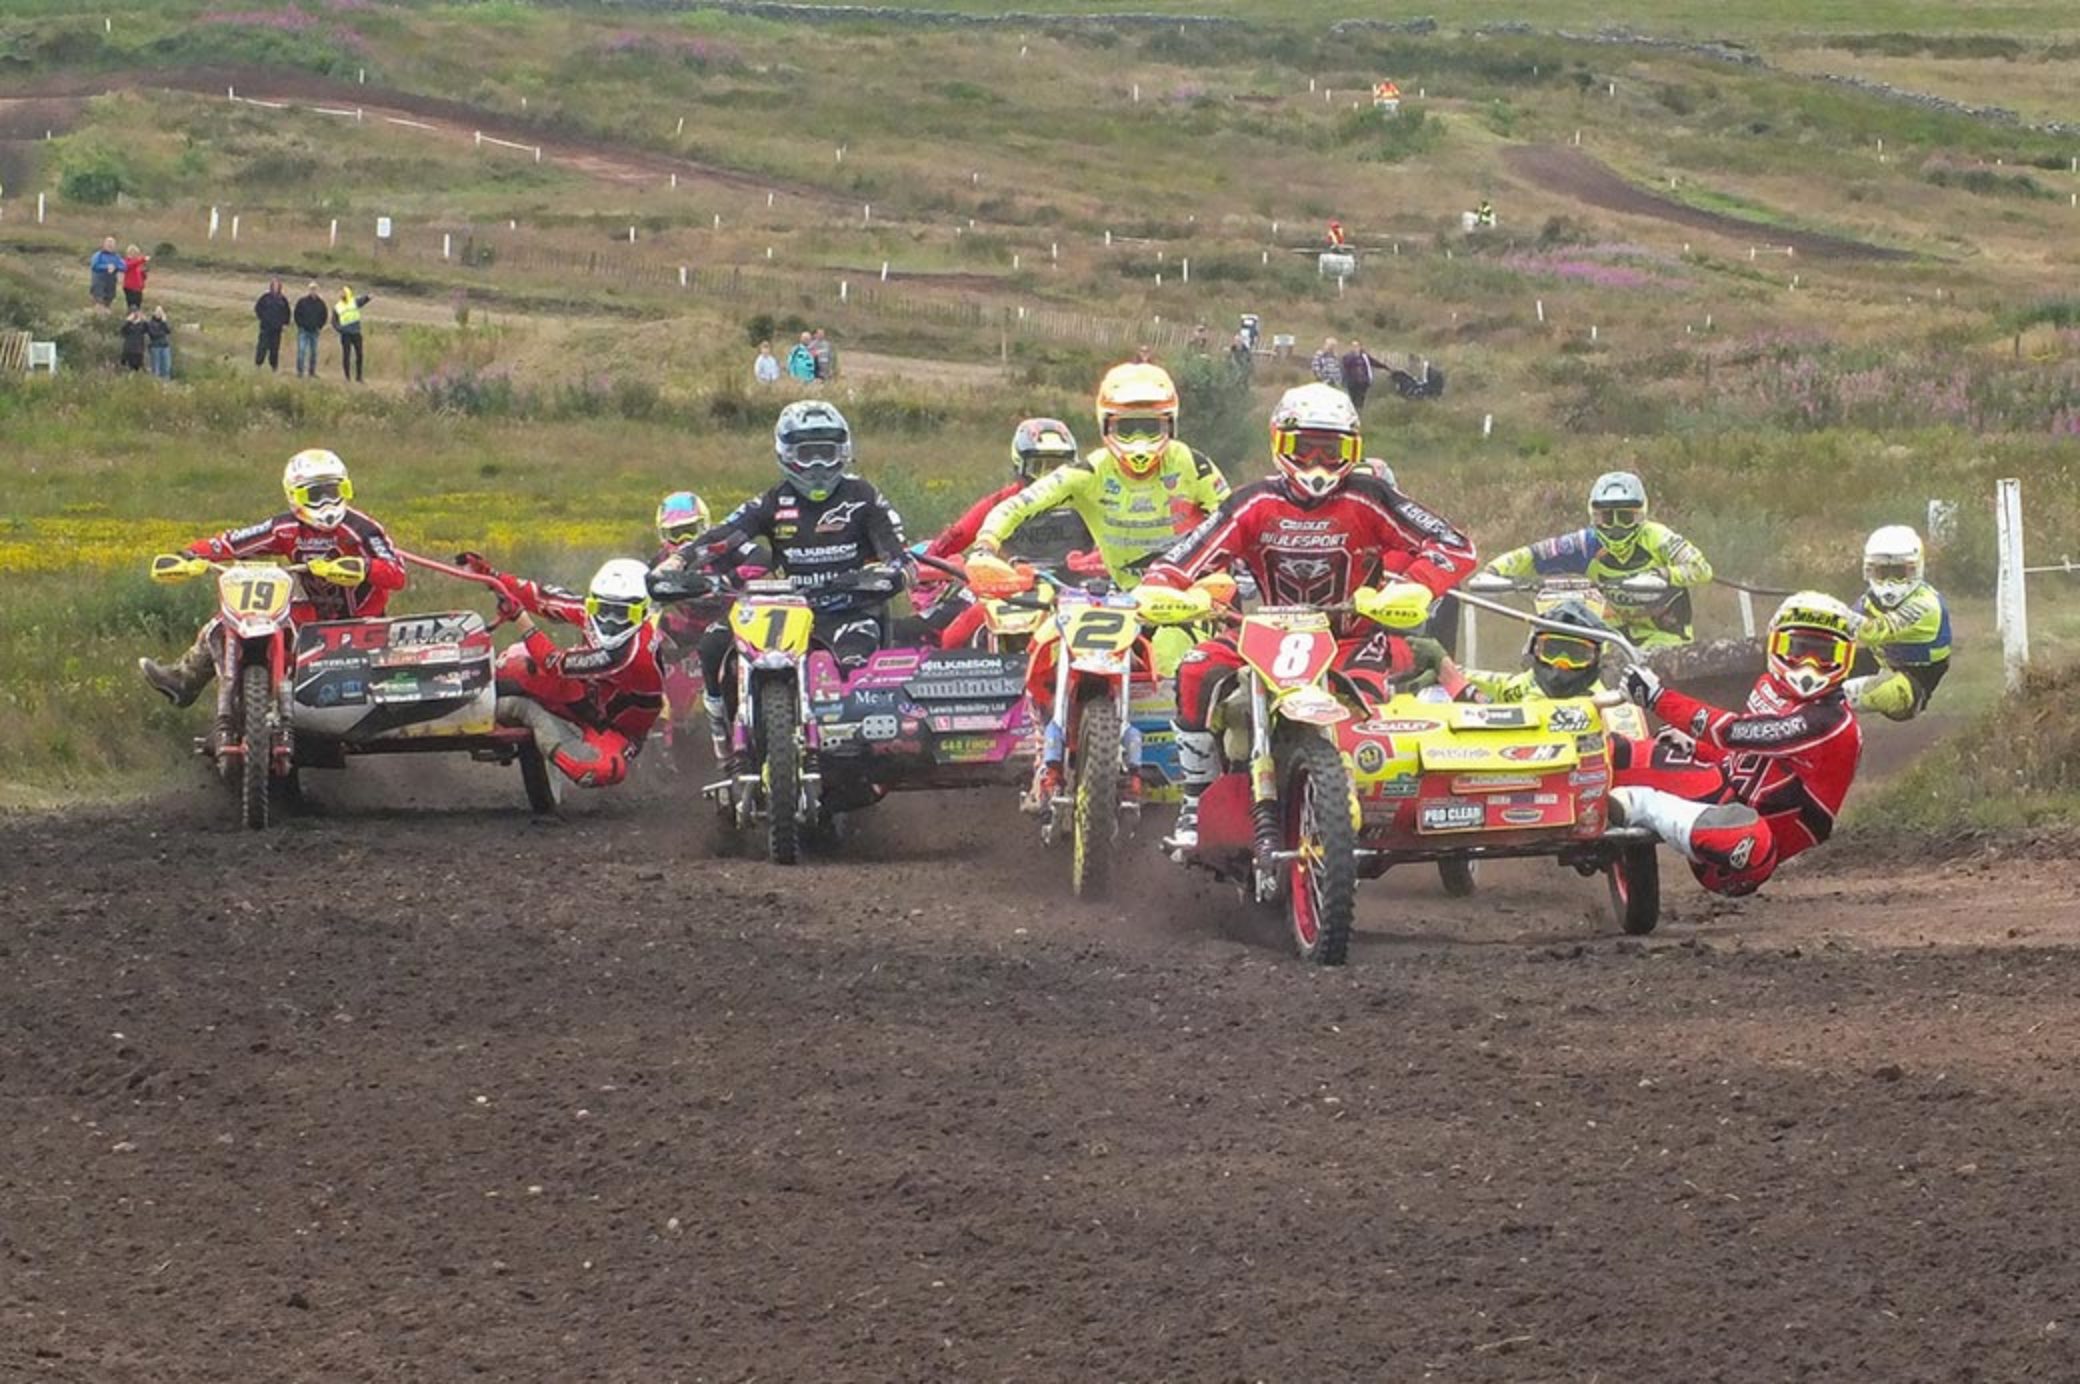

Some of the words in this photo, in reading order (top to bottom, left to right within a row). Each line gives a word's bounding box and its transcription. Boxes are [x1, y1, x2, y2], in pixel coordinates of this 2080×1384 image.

[240, 580, 275, 611] 19
[764, 608, 788, 649] 1
[1073, 611, 1126, 649] 2
[1272, 633, 1315, 678] 8
